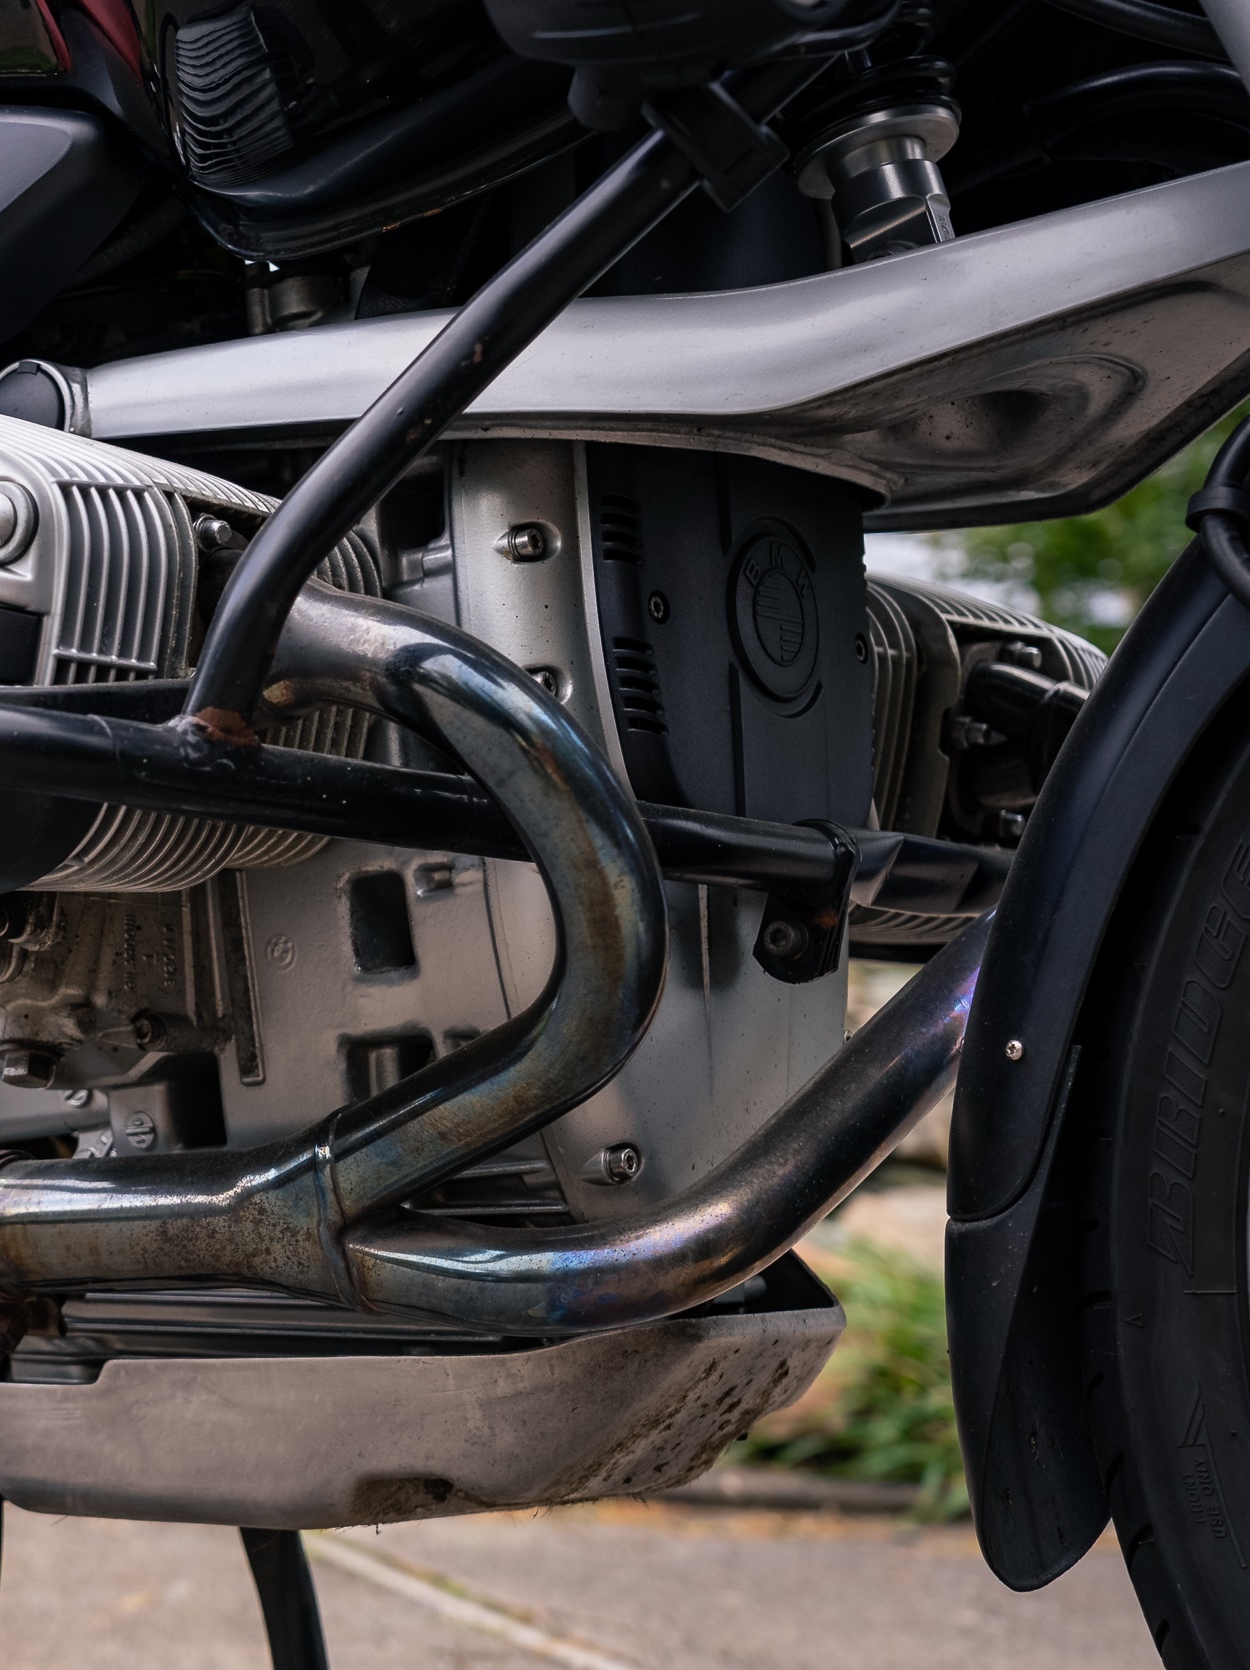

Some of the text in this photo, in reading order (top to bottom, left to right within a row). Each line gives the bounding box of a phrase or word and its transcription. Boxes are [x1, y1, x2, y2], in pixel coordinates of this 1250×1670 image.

[743, 542, 810, 598] BMW
[1183, 1473, 1207, 1524] FRONT
[1193, 1456, 1228, 1539] USE ONLY
